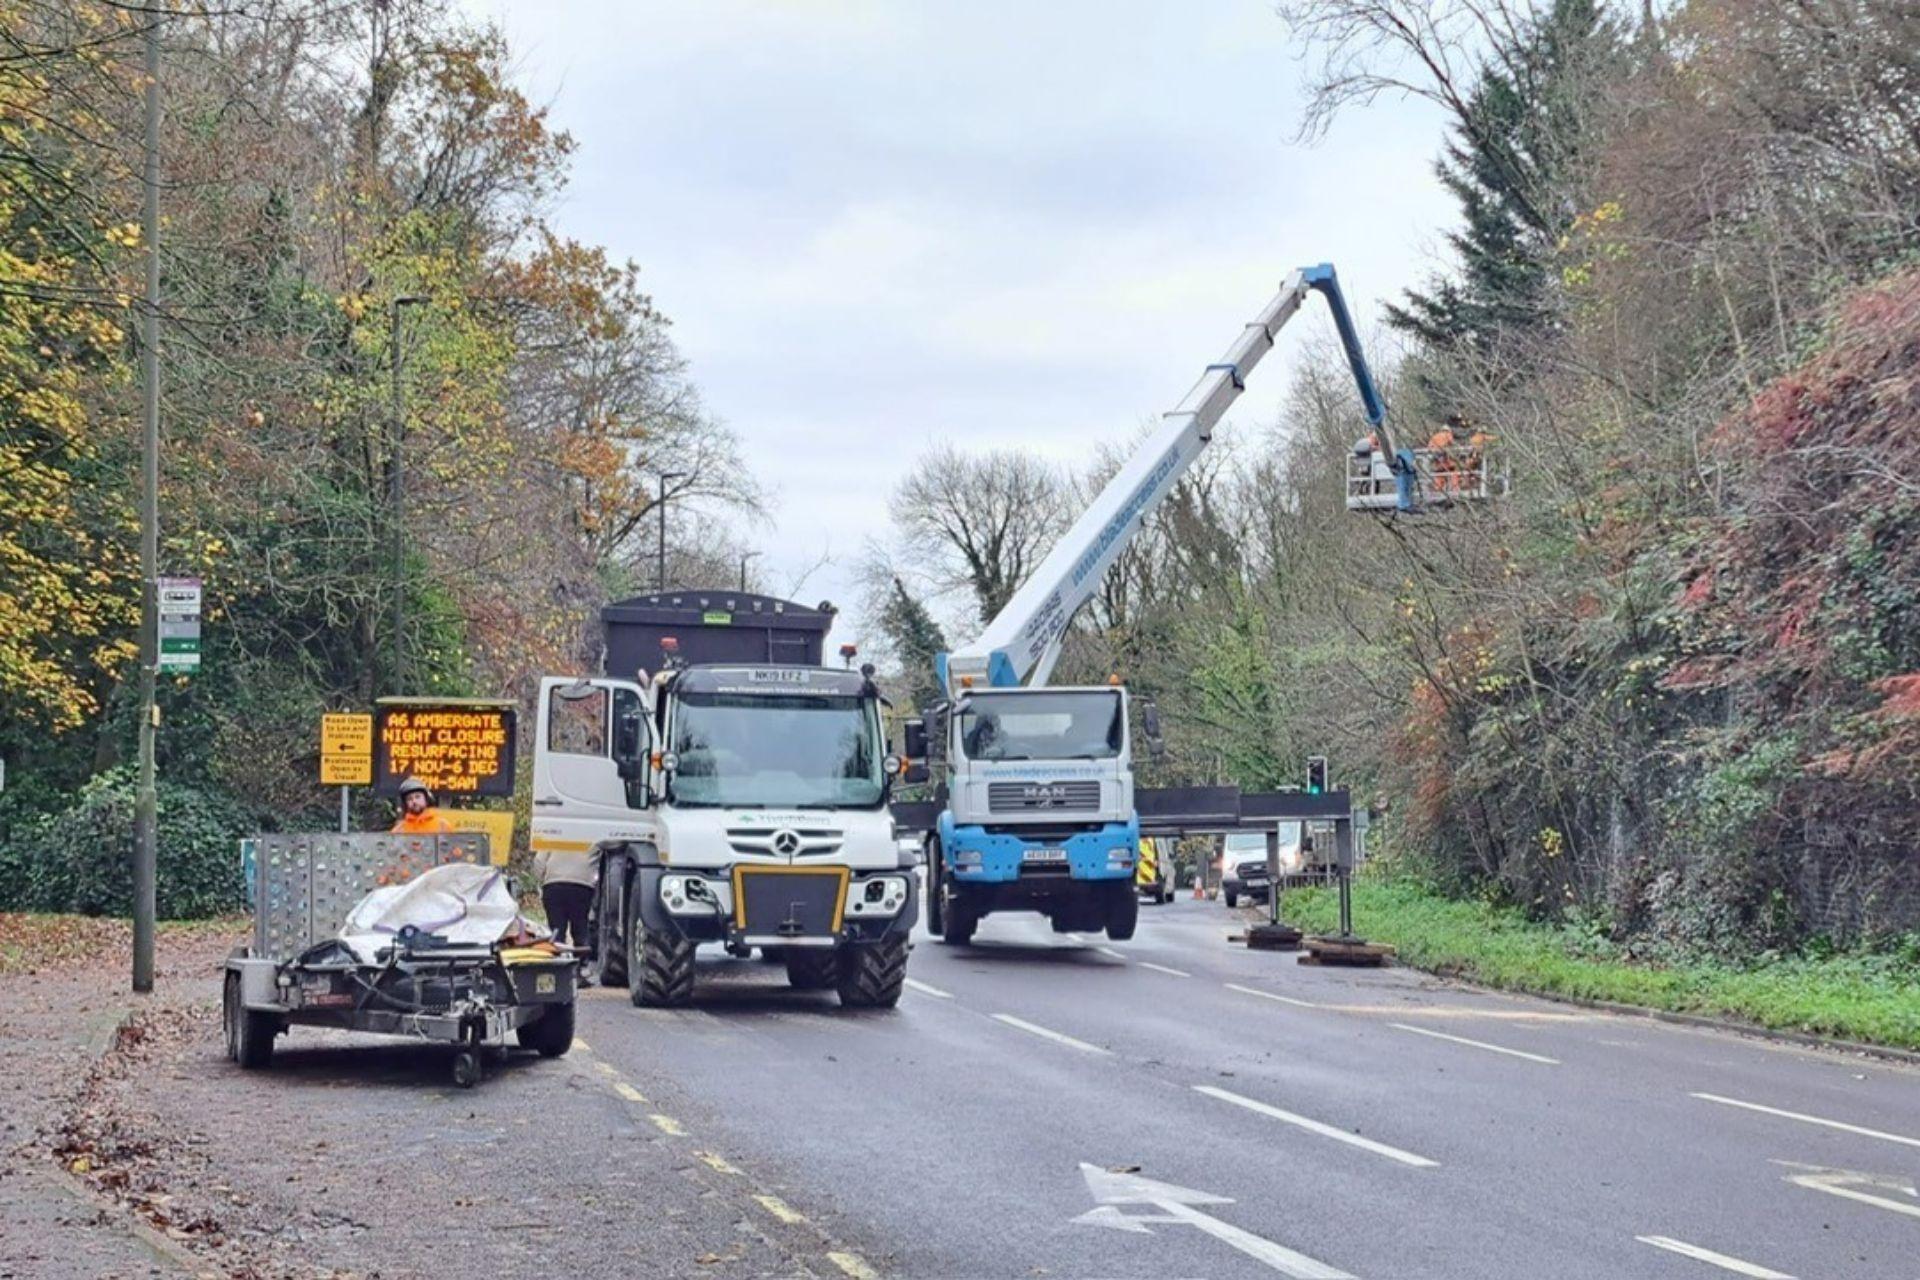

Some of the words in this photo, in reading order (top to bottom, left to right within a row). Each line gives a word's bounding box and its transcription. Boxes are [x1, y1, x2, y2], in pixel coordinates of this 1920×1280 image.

[754, 671, 779, 681] NK19
[782, 671, 803, 681] EFZ
[348, 716, 369, 725] Open
[388, 713, 409, 727] A6
[414, 713, 502, 729] AMBERGATE
[382, 728, 432, 743] NIGHT
[437, 729, 506, 744] CLOSURE
[390, 744, 497, 759] RESURFACING
[390, 760, 409, 774] 17
[414, 760, 463, 774] NOV-6
[468, 761, 498, 775] DEC
[418, 775, 478, 790] PM-5AM
[1024, 788, 1066, 797] MAN
